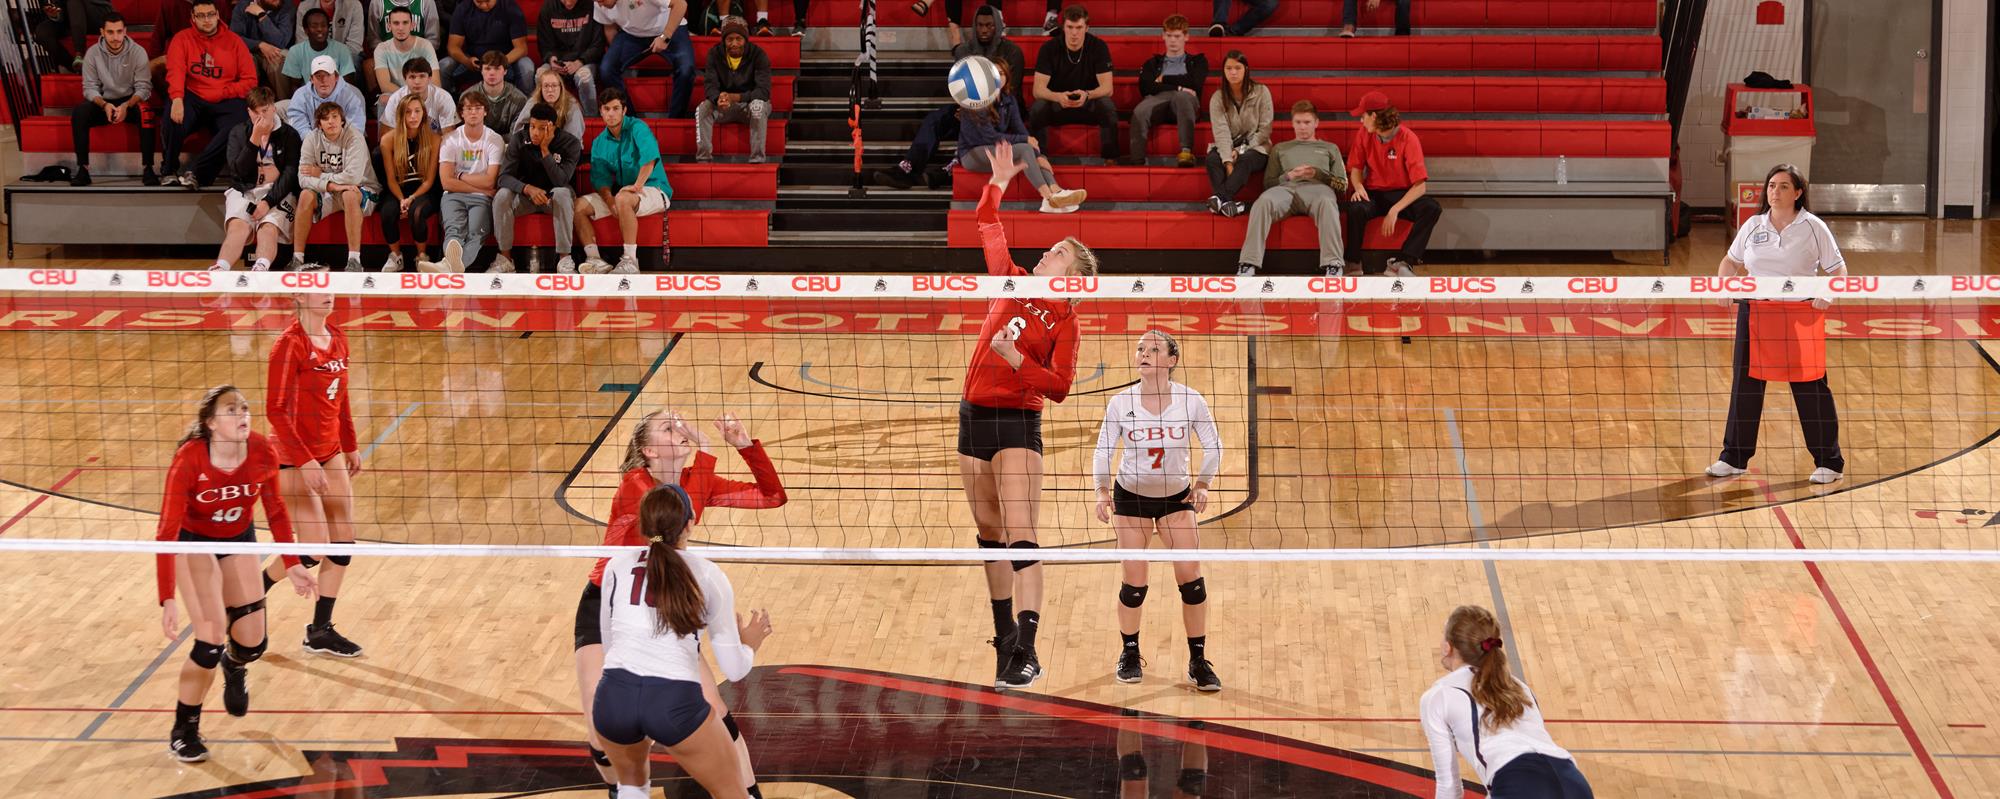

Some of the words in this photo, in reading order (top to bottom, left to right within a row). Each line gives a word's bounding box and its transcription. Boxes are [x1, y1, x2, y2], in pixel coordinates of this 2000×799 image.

[189, 63, 224, 79] CBU
[28, 269, 77, 285] CBU
[147, 271, 211, 287] BUCS
[281, 272, 330, 288] CBU
[400, 273, 466, 289] BUCS
[535, 274, 585, 290] CBU
[655, 275, 722, 291] BUCS
[791, 276, 841, 292] CBU
[912, 276, 978, 292] BUCS
[1048, 276, 1099, 292] CBU
[1169, 277, 1237, 293] BUCS
[1307, 277, 1358, 293] CBU
[1429, 277, 1497, 293] BUCS
[1567, 277, 1618, 293] CBU
[1689, 276, 1757, 292] BUCS
[1828, 276, 1879, 292] CBU
[0, 310, 526, 328] RISTAN
[326, 377, 340, 400] 4
[1127, 426, 1187, 442] CBU
[1147, 447, 1165, 470] 7
[195, 483, 264, 504] CBU
[211, 506, 243, 523] 10
